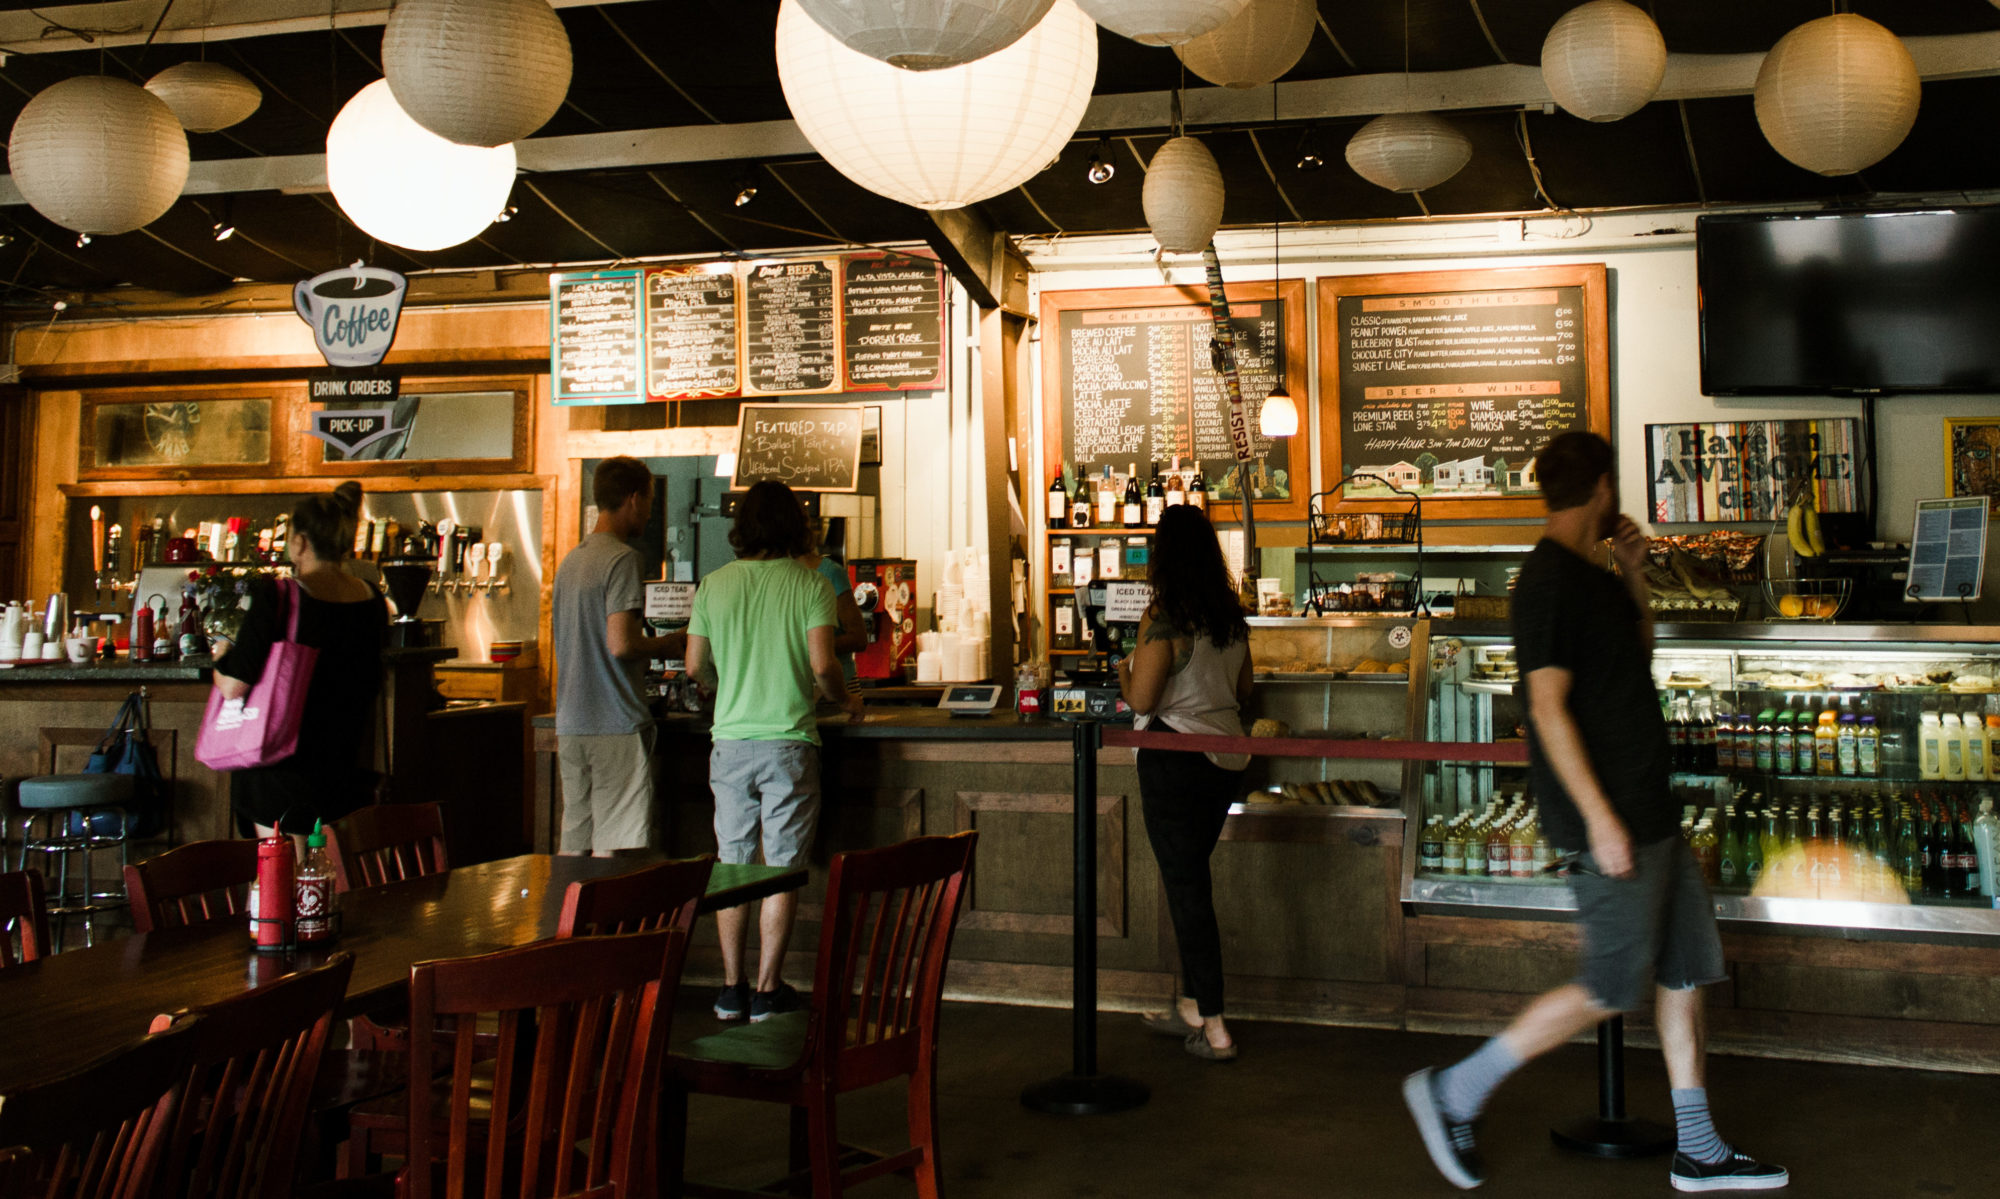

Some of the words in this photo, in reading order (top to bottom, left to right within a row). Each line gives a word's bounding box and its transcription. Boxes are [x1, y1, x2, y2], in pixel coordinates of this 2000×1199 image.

[786, 264, 818, 275] BEER
[1399, 295, 1519, 307] SMOOTHIES
[1108, 308, 1233, 320] CHERRYWOD
[322, 304, 391, 348] Coffee
[1350, 316, 1381, 326] CLASSIC
[1071, 328, 1104, 338] BREWED
[1105, 326, 1137, 337] COFFEE
[1192, 323, 1211, 333] HOT
[1350, 327, 1379, 338] PEANUT
[1381, 326, 1407, 336] POWER
[1104, 335, 1123, 346] LAIT
[1351, 338, 1393, 349] BLUEBERRY
[1394, 337, 1418, 347] BLAST
[1072, 346, 1100, 356] MOCHA
[1114, 344, 1134, 356] LAIT
[1351, 350, 1392, 360] CHOCOLATE
[1394, 349, 1413, 359] CITY
[1072, 355, 1115, 366] ESPRESSO
[1352, 361, 1383, 372] SUNSET
[1385, 361, 1406, 371] LANE
[1073, 363, 1120, 374] AMERICANO
[1072, 372, 1123, 383] CAPPUCCINO
[314, 381, 347, 396] DRINK
[350, 380, 392, 395] ORDERS
[1072, 382, 1101, 391] MOCHA
[1101, 380, 1148, 391] CAPPUCCINO
[1386, 388, 1436, 396] BEER
[1487, 384, 1536, 393] WINE
[1073, 390, 1102, 401] LATTE
[1073, 400, 1102, 409] MOCHA
[1104, 398, 1132, 409] LATTE
[1470, 400, 1495, 411] WINE
[1074, 409, 1094, 419] ICED
[1095, 408, 1126, 418] COFFEE
[1352, 410, 1392, 422] PREMIUM
[1393, 410, 1414, 421] BEER
[1470, 410, 1518, 422] CHAMPAGNE
[329, 418, 374, 433] PICK-UP
[754, 420, 816, 435] FEATURED
[820, 421, 848, 436] TAP
[1074, 417, 1120, 427] CORTADITO
[1352, 421, 1374, 432] LONE
[1376, 421, 1397, 431] STAR
[1470, 421, 1504, 432] MIMOSA
[1074, 427, 1100, 437] CUBAN
[1102, 426, 1118, 436] CON
[1120, 425, 1146, 435] LECHE
[1231, 410, 1250, 461] RESIST
[752, 436, 796, 454] Ballast
[804, 436, 829, 455] Point
[1074, 435, 1121, 445] HOUSEMADE
[1124, 434, 1143, 444] CHAI
[1364, 437, 1398, 450] HAPPY
[1396, 436, 1427, 449] HOUR
[1461, 437, 1491, 448] DAILY
[1678, 429, 1768, 456] Have
[1074, 445, 1088, 455] HOT
[1092, 443, 1138, 454] CHOCOLATE
[1074, 454, 1095, 463] MILK
[823, 457, 850, 479] IPA
[1655, 453, 1850, 484] AWESOME
[1718, 486, 1780, 514] day
[1116, 588, 1135, 596] ICED
